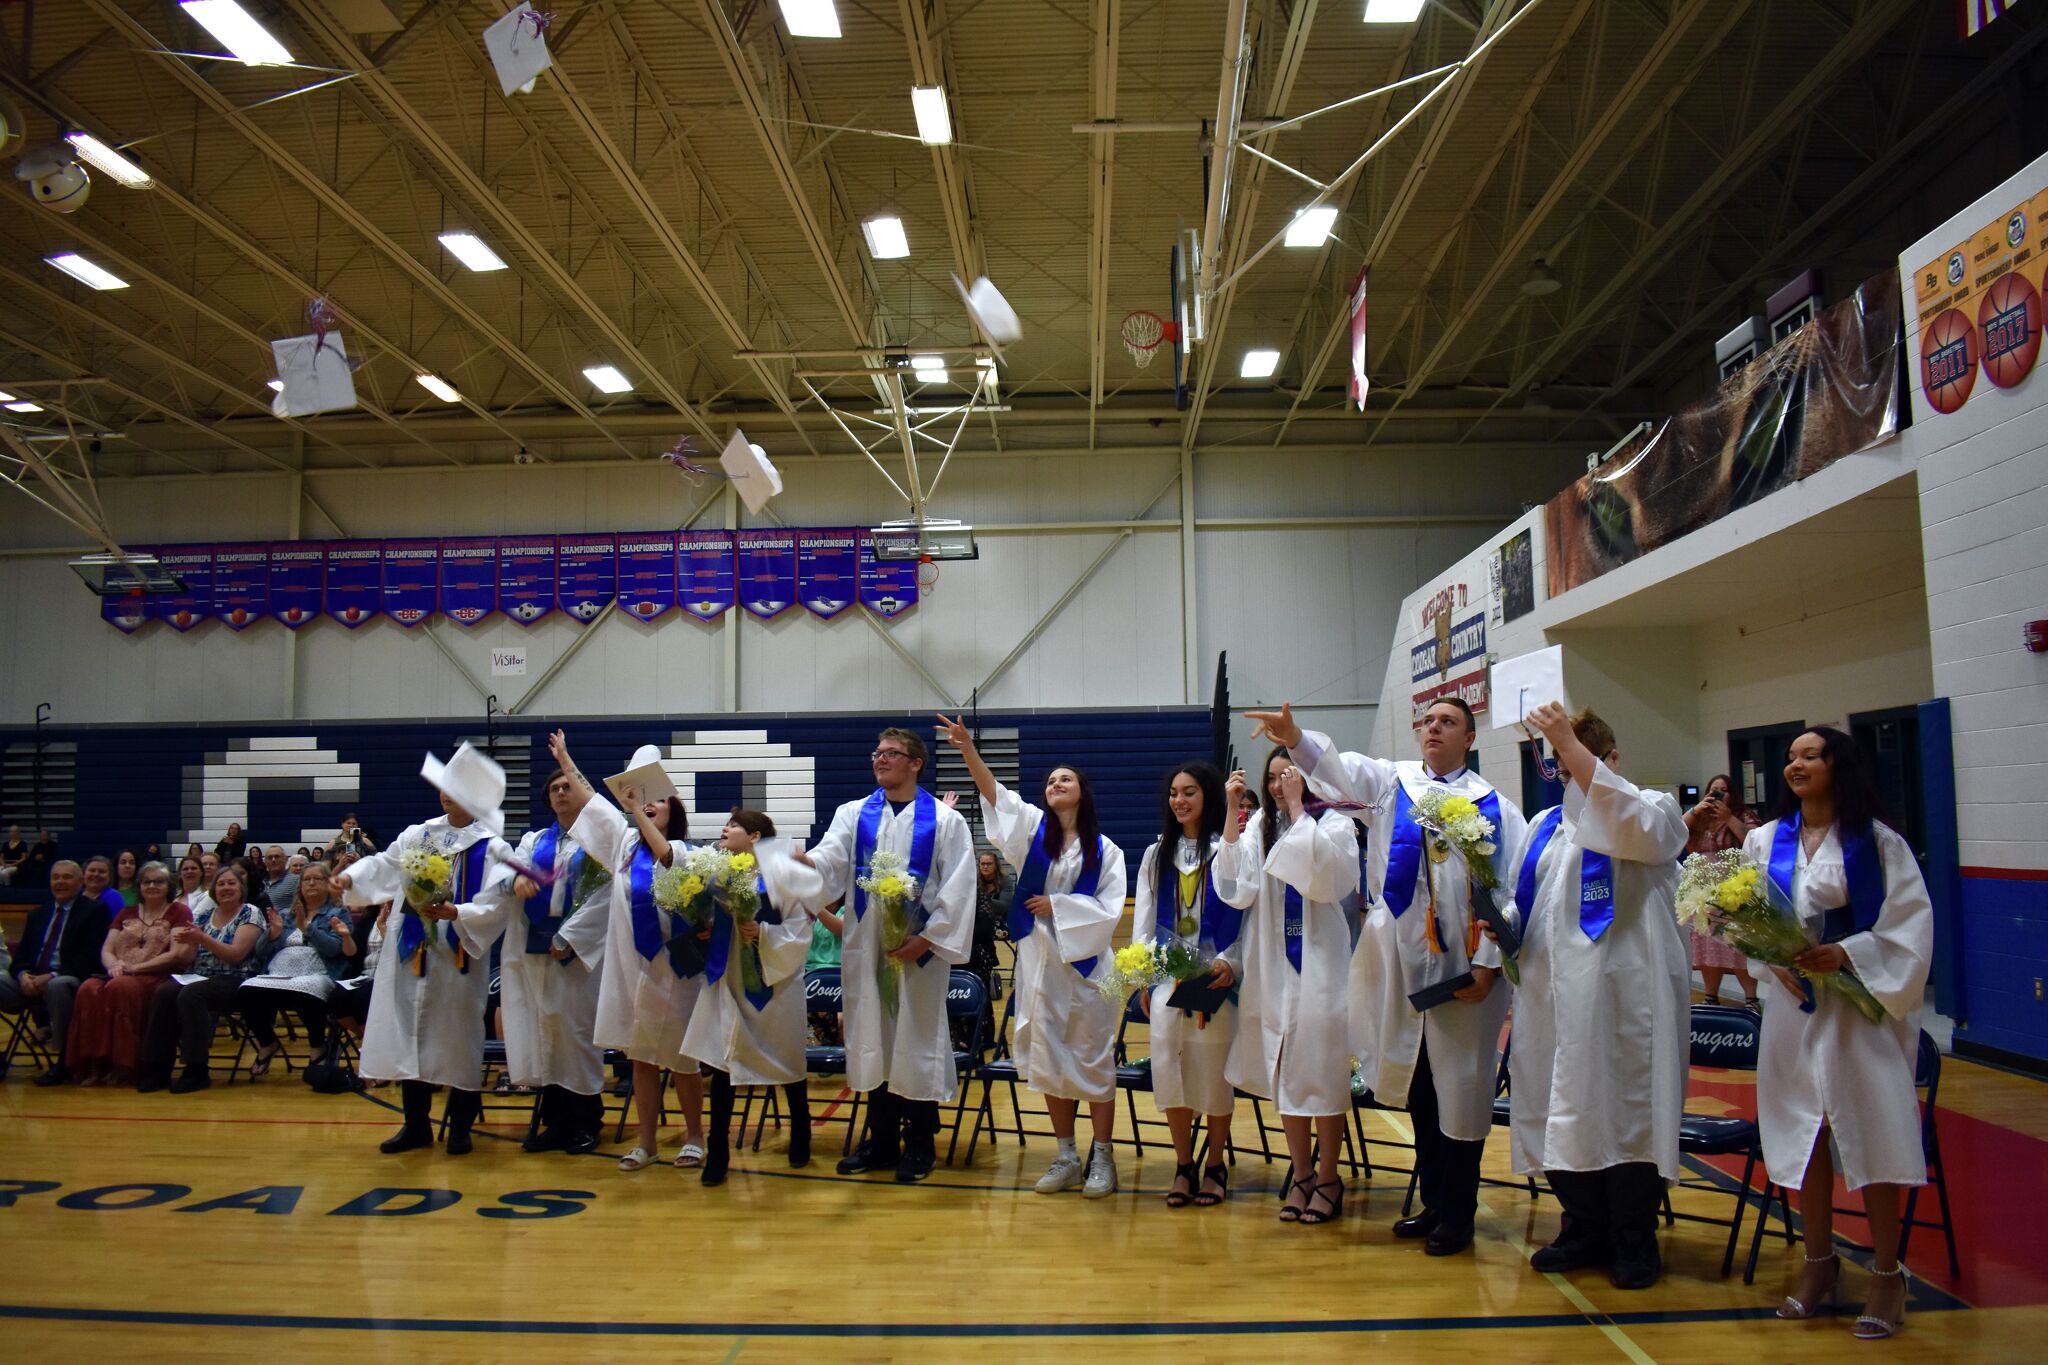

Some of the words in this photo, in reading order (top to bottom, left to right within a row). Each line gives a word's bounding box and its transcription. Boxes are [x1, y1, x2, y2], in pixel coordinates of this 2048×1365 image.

[1987, 315, 2025, 357] 2017
[1930, 349, 1965, 386] 2011
[619, 543, 674, 553] CHAMPIONSHIPS
[679, 540, 733, 550] CHAMPIONSHIPS
[739, 539, 794, 549] CHAMPIONSHIPS
[800, 539, 855, 548] CHAMPIONSHIPS
[443, 549, 496, 558] CHAMPIONSHIPS
[501, 547, 554, 556] CHAMPIONSHIPS
[560, 545, 614, 554] CHAMPIONSHIPS
[216, 553, 267, 562] CHAMPIONSHIPS
[272, 551, 323, 560] CHAMPIONSHIPS
[328, 550, 380, 559] CHAMPIONSHIPS
[385, 550, 438, 559] CHAMPIONSHIPS
[161, 555, 212, 564] CHAMPIONSHIPS
[1422, 585, 1454, 629] WELCOME
[1458, 584, 1468, 607] TO
[1451, 621, 1484, 659] COUNTRY
[1584, 888, 1610, 901] 2023
[1287, 927, 1303, 936] 202
[806, 979, 842, 1001] Coug
[1690, 1029, 1754, 1054] ougars
